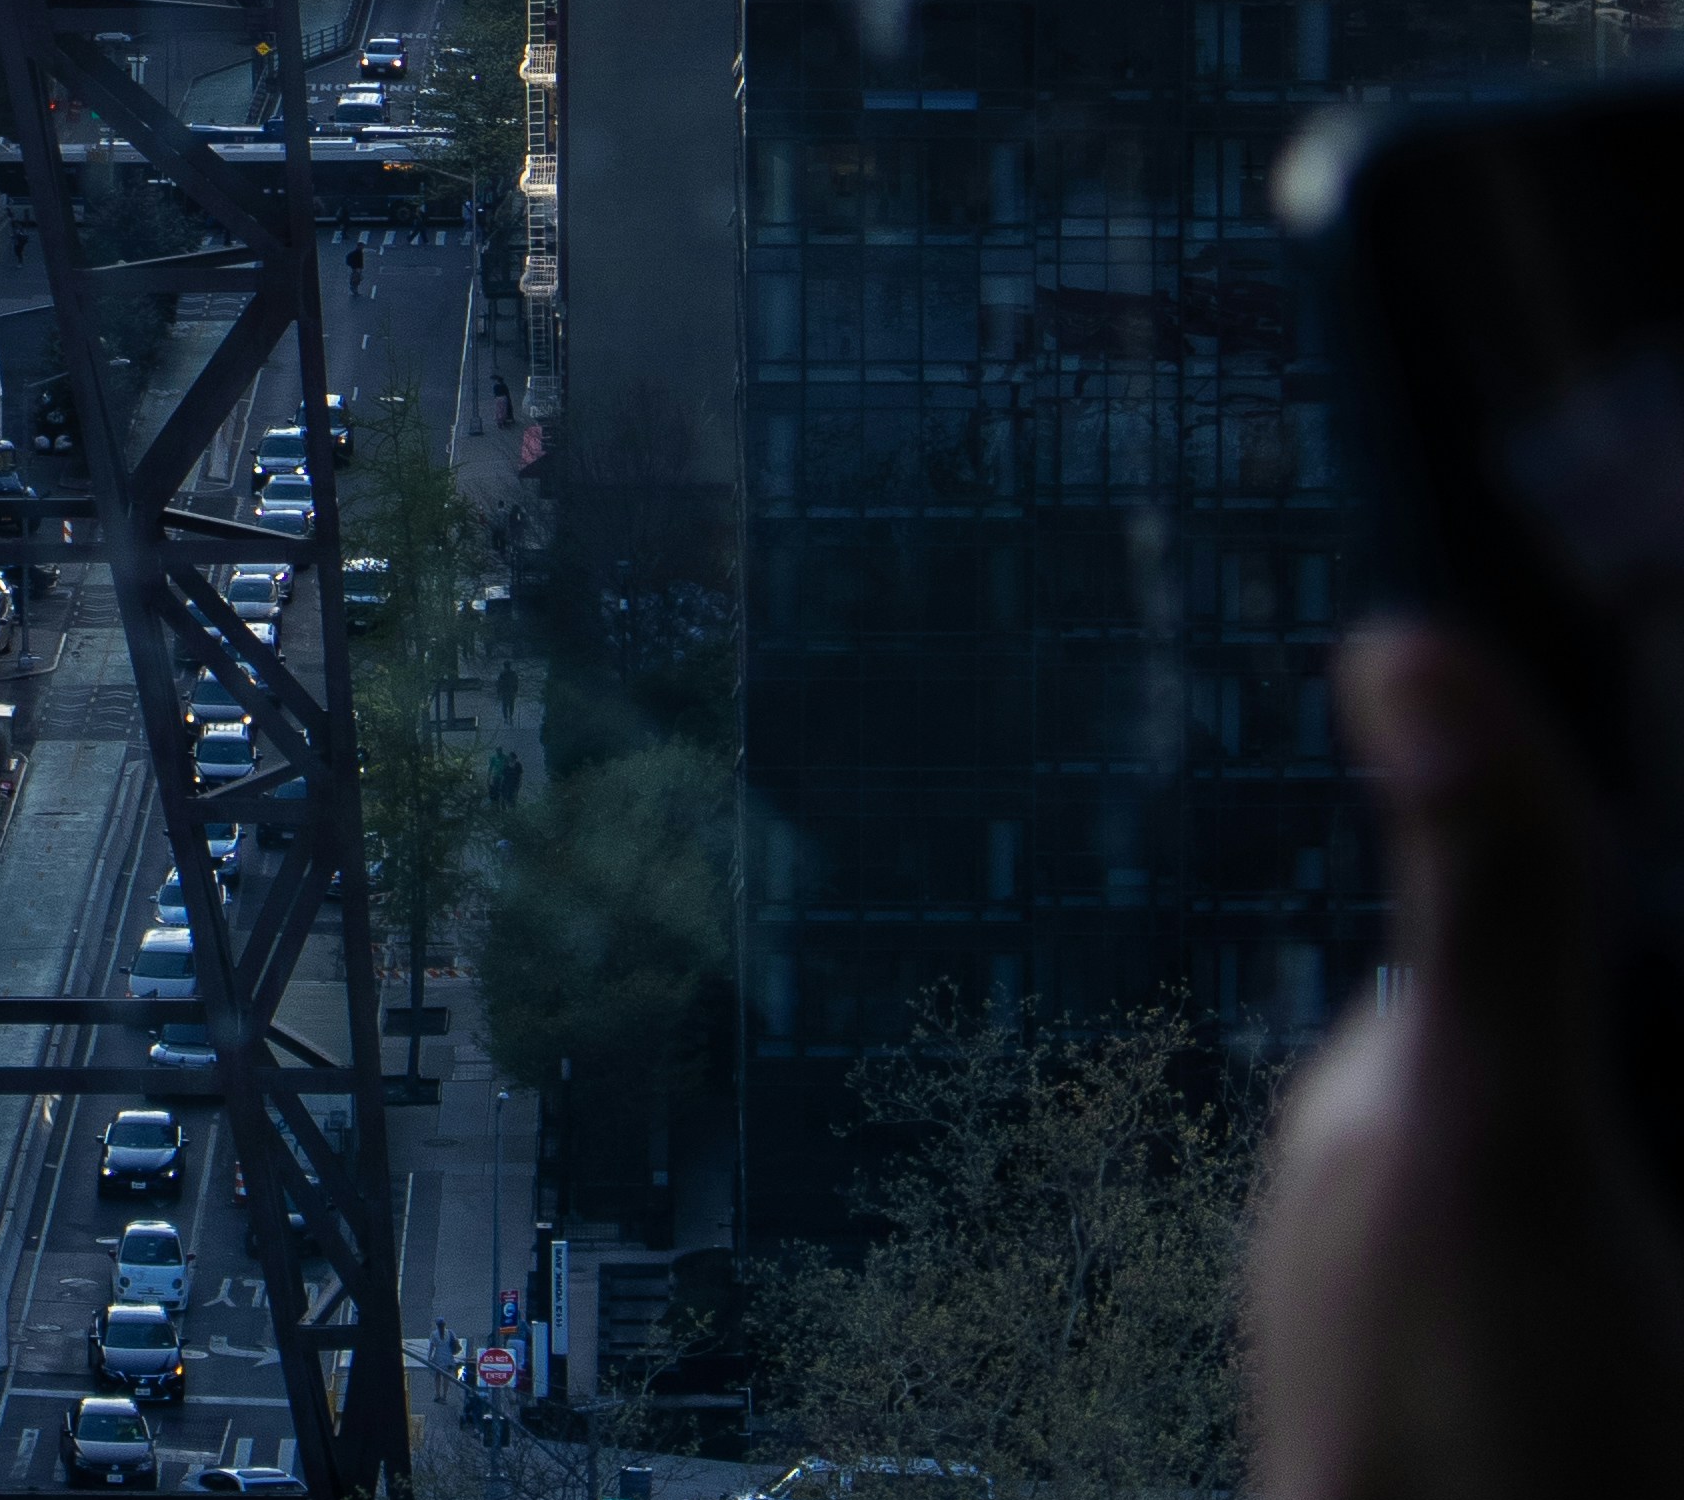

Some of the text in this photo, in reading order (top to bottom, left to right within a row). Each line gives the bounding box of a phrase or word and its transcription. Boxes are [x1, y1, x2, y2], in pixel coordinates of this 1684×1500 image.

[555, 1248, 563, 1270] AVE
[555, 1272, 563, 1303] YORK
[484, 1355, 494, 1363] DO
[485, 1372, 507, 1380] ENTER
